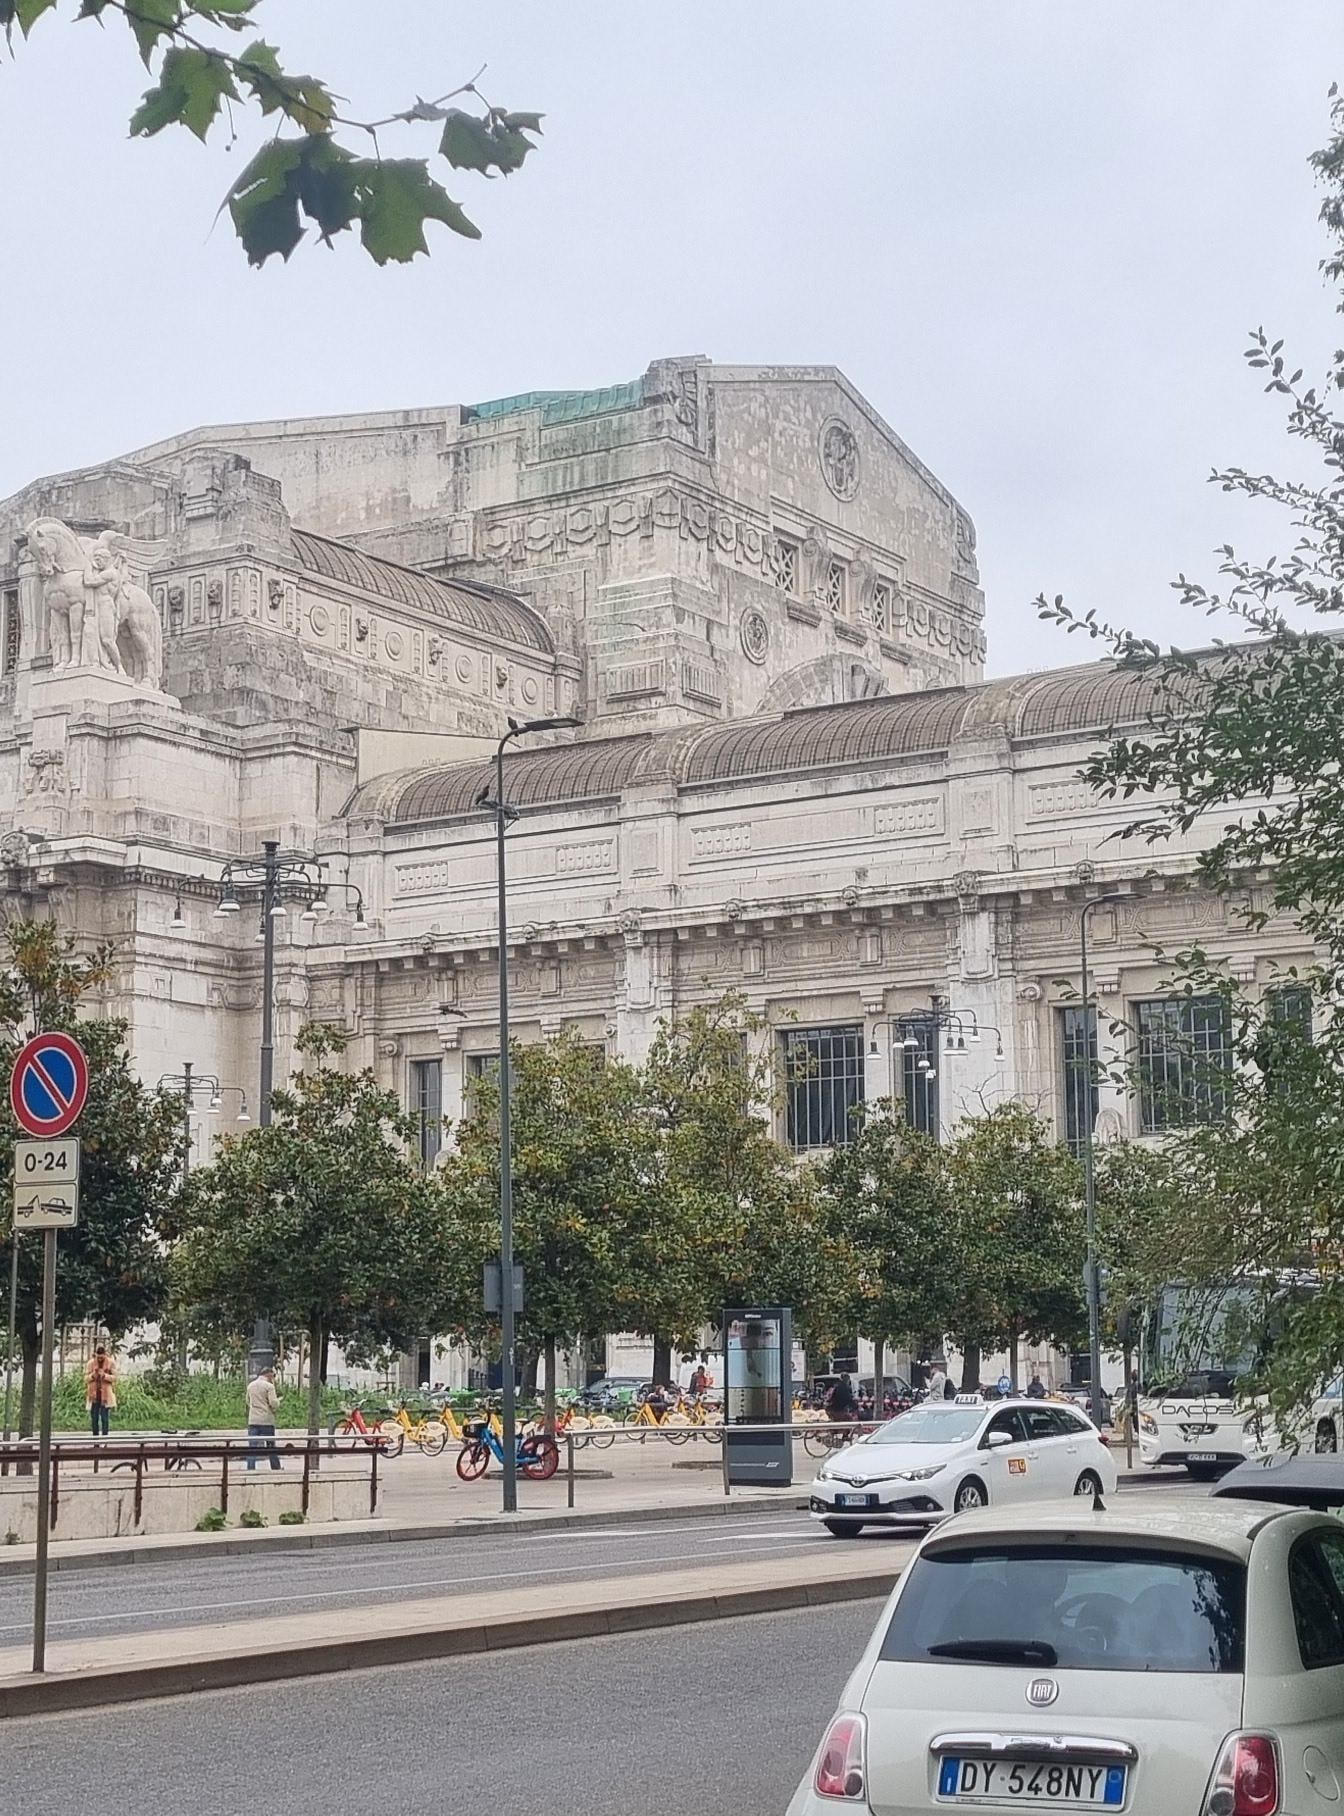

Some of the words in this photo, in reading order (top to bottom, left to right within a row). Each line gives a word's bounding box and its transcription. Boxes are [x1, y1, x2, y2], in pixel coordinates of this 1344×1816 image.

[24, 1151, 68, 1173] 0-24
[1032, 1684, 1052, 1699] FIAT
[960, 1761, 997, 1794] DY
[1008, 1763, 1104, 1799] 548NY
